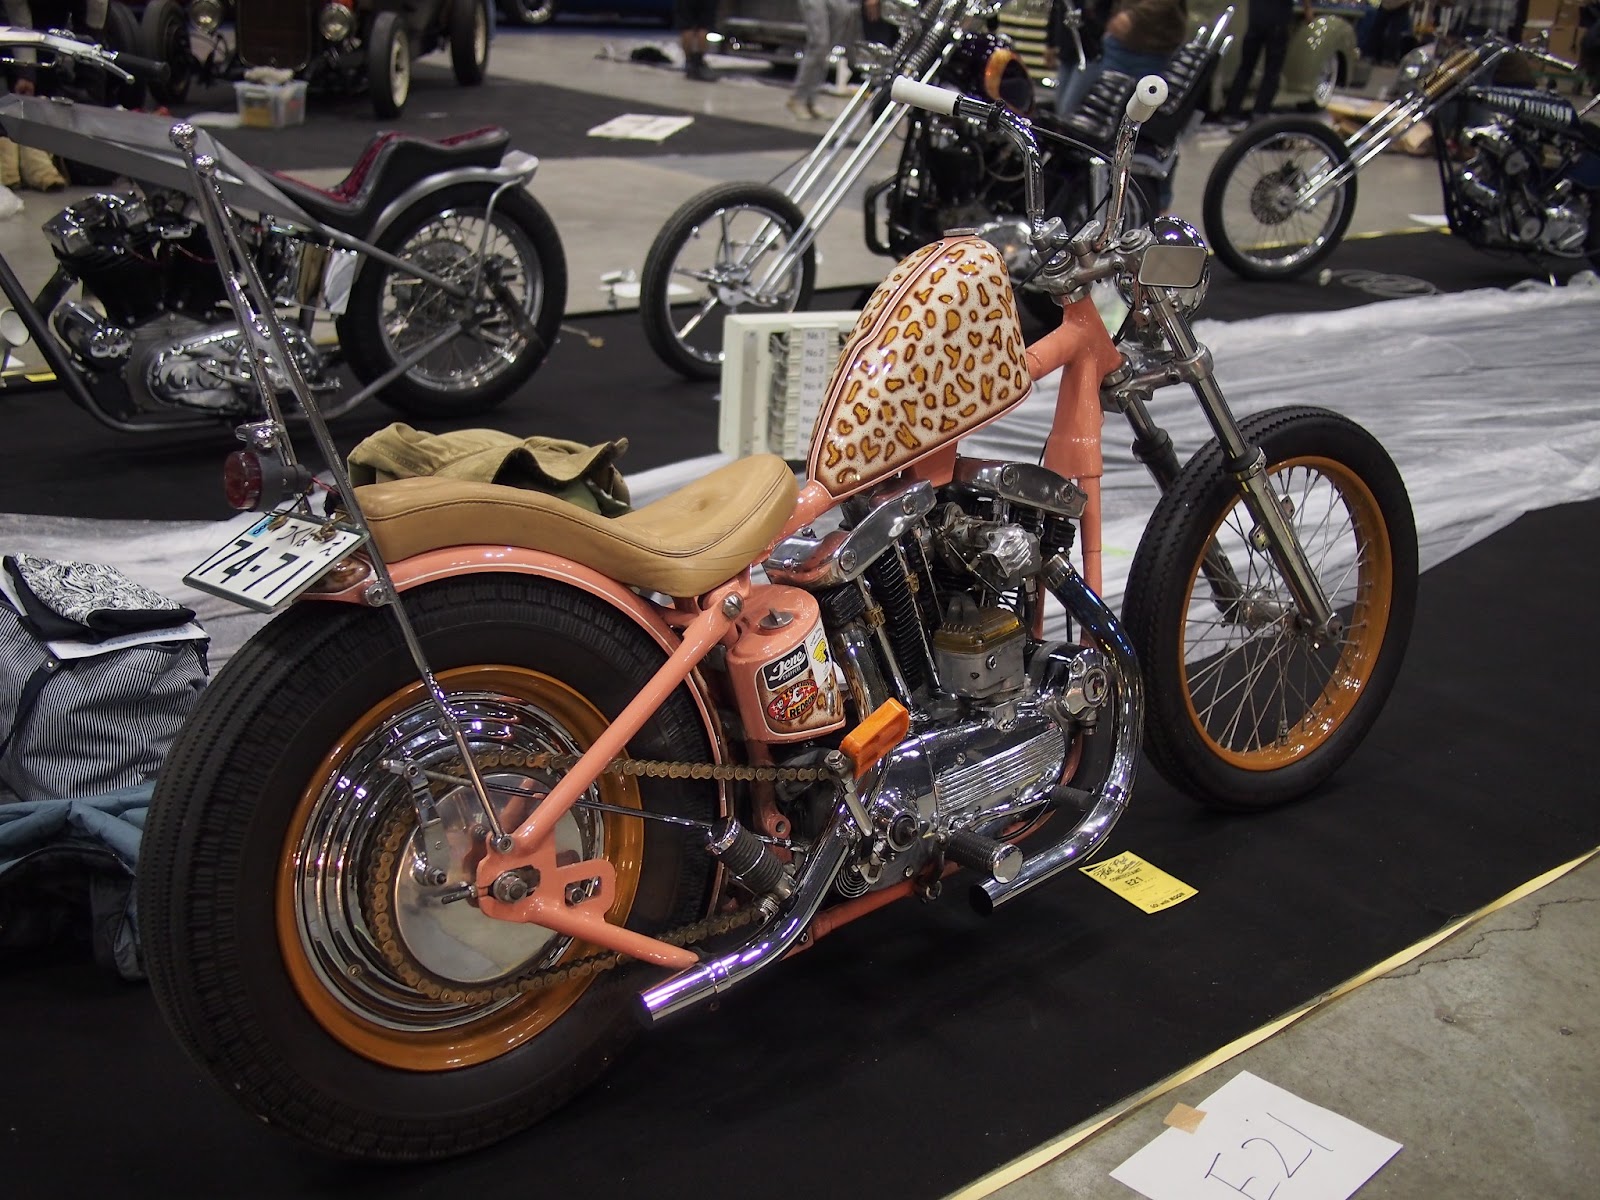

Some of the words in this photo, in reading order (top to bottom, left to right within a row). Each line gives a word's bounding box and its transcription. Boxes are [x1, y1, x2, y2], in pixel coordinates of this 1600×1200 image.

[319, 536, 347, 557] え
[198, 539, 314, 600] 74-71
[768, 649, 807, 682] Jene
[1125, 876, 1144, 887] E21
[1203, 1111, 1334, 1200] E21
